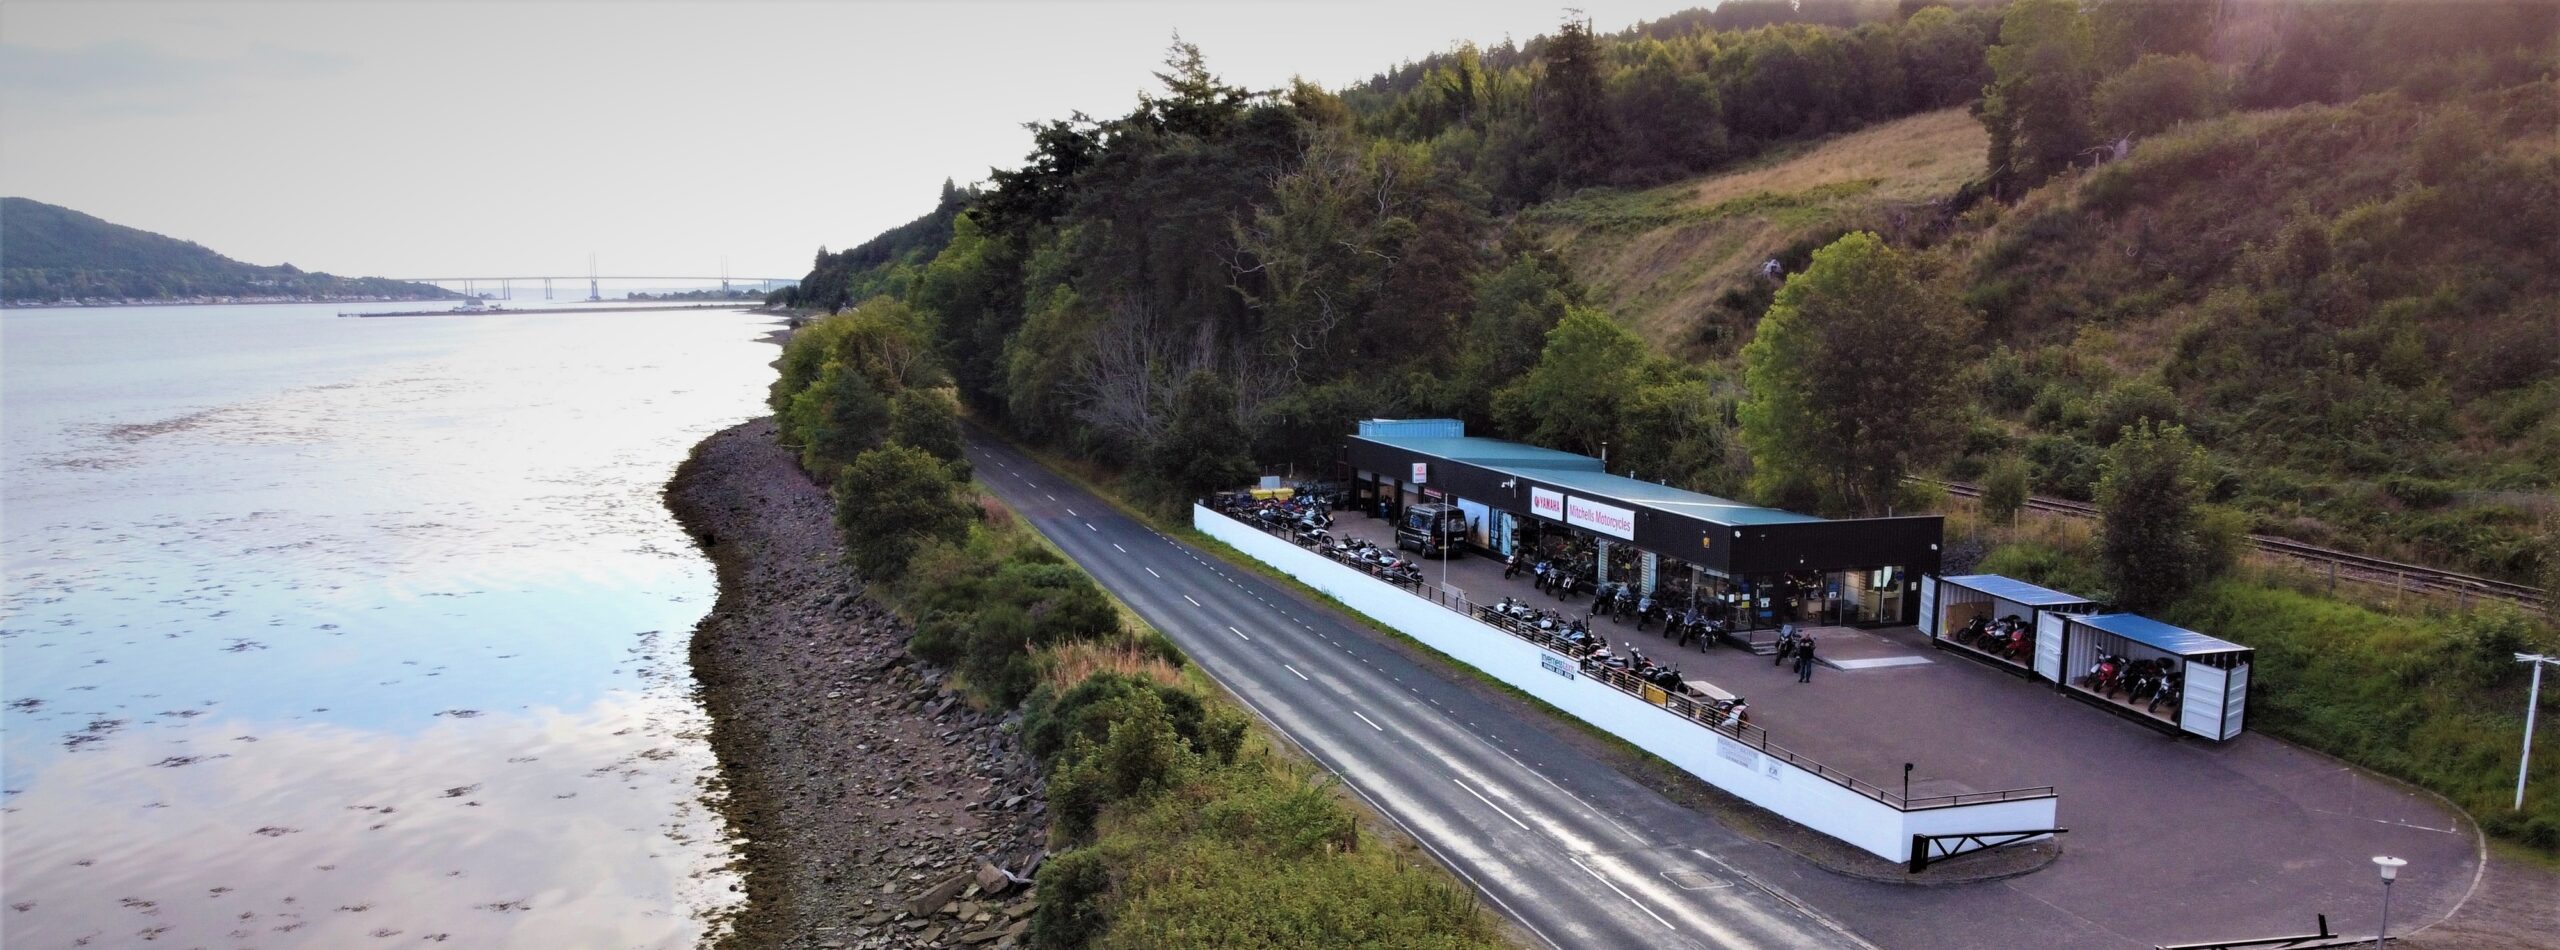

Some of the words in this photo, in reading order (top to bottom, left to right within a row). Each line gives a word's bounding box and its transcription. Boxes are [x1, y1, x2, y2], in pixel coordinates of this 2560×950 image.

[1540, 496, 1560, 513] YAMAHA
[1569, 503, 1595, 522] Mitchells
[1595, 510, 1631, 532] Motorcycles
